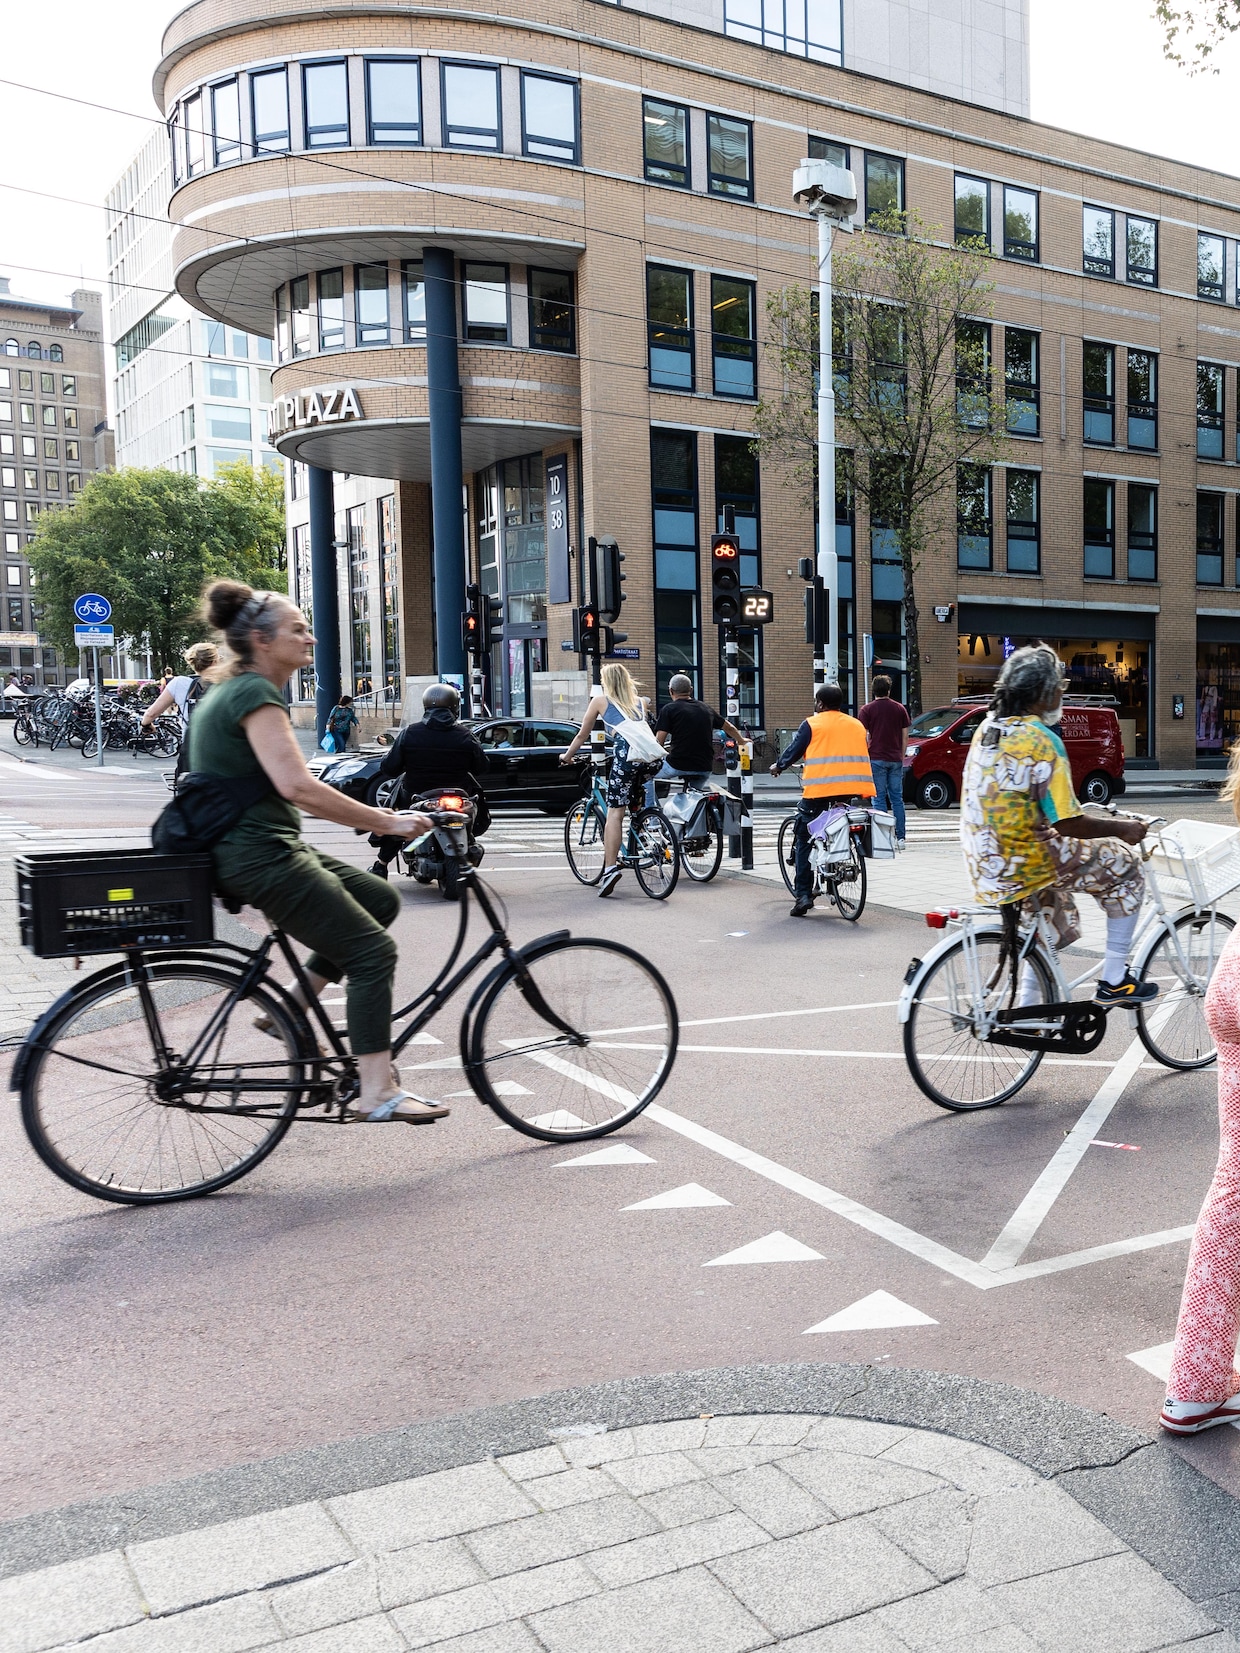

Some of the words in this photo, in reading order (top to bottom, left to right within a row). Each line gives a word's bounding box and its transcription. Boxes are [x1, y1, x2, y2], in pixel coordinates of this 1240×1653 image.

[285, 388, 363, 429] PLAZA
[550, 475, 560, 495] 10
[551, 509, 562, 529] 38
[745, 598, 769, 615] 22
